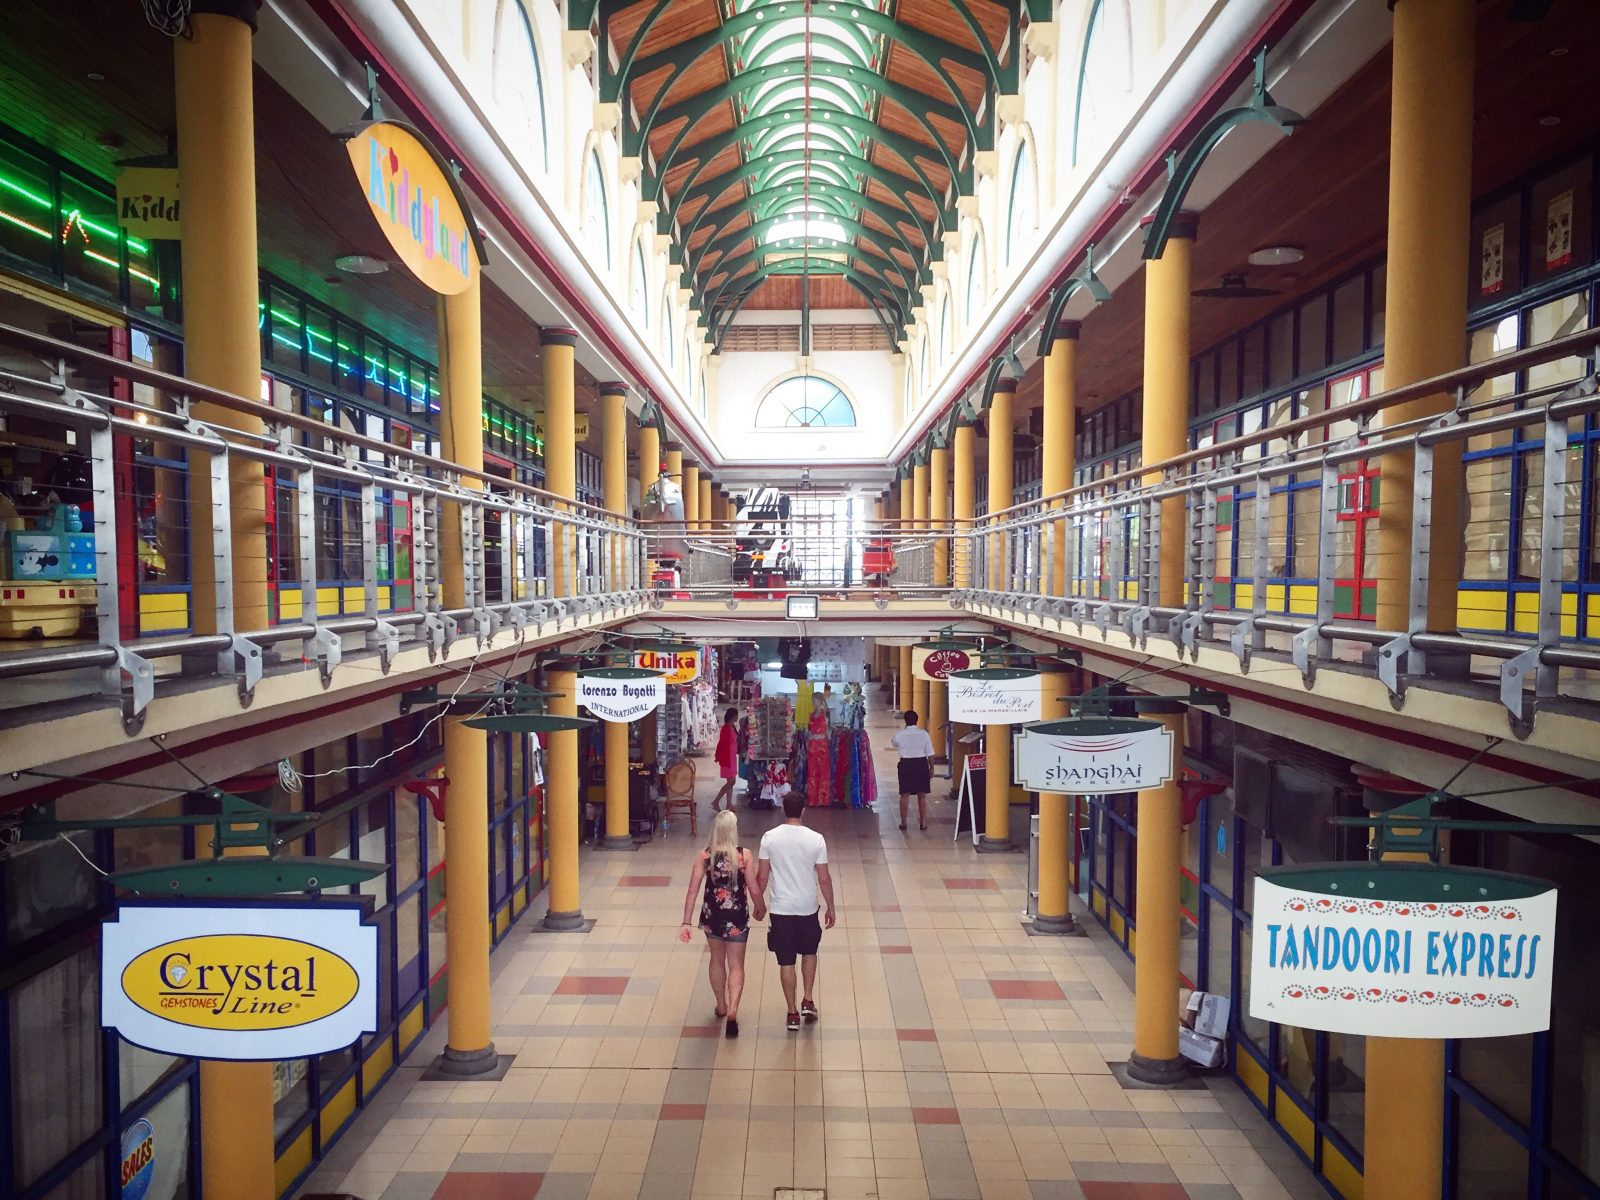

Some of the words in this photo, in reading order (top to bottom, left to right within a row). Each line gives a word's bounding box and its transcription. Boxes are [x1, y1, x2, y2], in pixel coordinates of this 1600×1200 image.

[122, 195, 180, 222] Kidd
[369, 137, 470, 279] Kiddyland
[640, 652, 696, 669] Unika
[623, 684, 656, 699] Bugatti
[590, 702, 649, 718] INTERNATIONAL
[1266, 923, 1412, 976] TANDOORI
[1426, 930, 1541, 980] EXPRESS
[159, 952, 317, 1015] Crystal
[160, 997, 218, 1009] GEMSTONES
[227, 996, 293, 1014] Line
[121, 1137, 153, 1186] SALES
